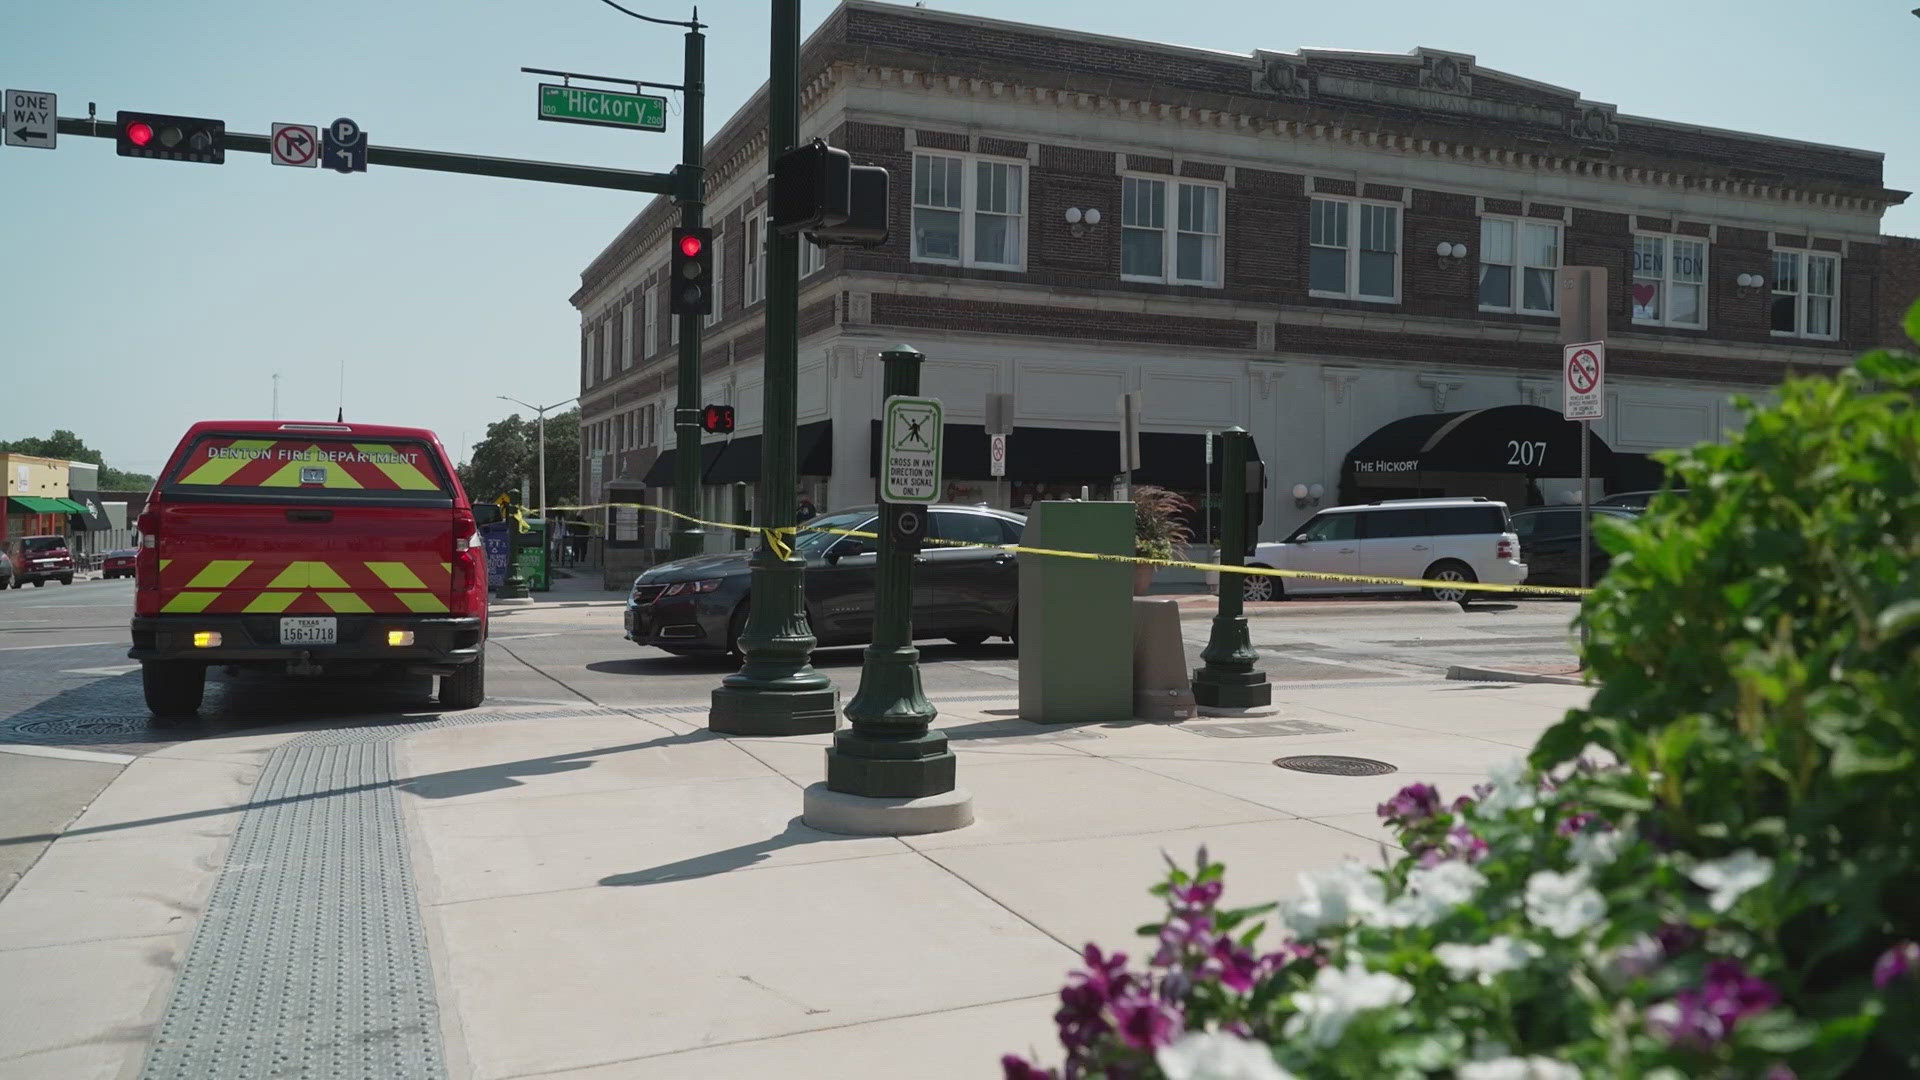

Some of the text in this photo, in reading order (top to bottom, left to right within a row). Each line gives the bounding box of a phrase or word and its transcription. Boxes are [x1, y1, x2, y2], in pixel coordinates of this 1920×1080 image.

[15, 95, 48, 110] ONE
[568, 90, 646, 123] Hickory
[543, 105, 556, 114] 100
[14, 110, 48, 125] WAY
[647, 115, 661, 125] 200
[339, 123, 354, 141] P
[725, 411, 732, 428] 5
[208, 447, 418, 465] DENTON FIRE DEPARTMENT
[1507, 440, 1547, 467] 207
[890, 458, 934, 468] CROSS IN ANY
[1354, 460, 1419, 472] THE HICKORY
[890, 467, 934, 477] DIRECTION ON
[890, 478, 933, 487] WALK SIGNAL
[903, 487, 920, 496] ONLY
[284, 628, 333, 640] 156-1718
